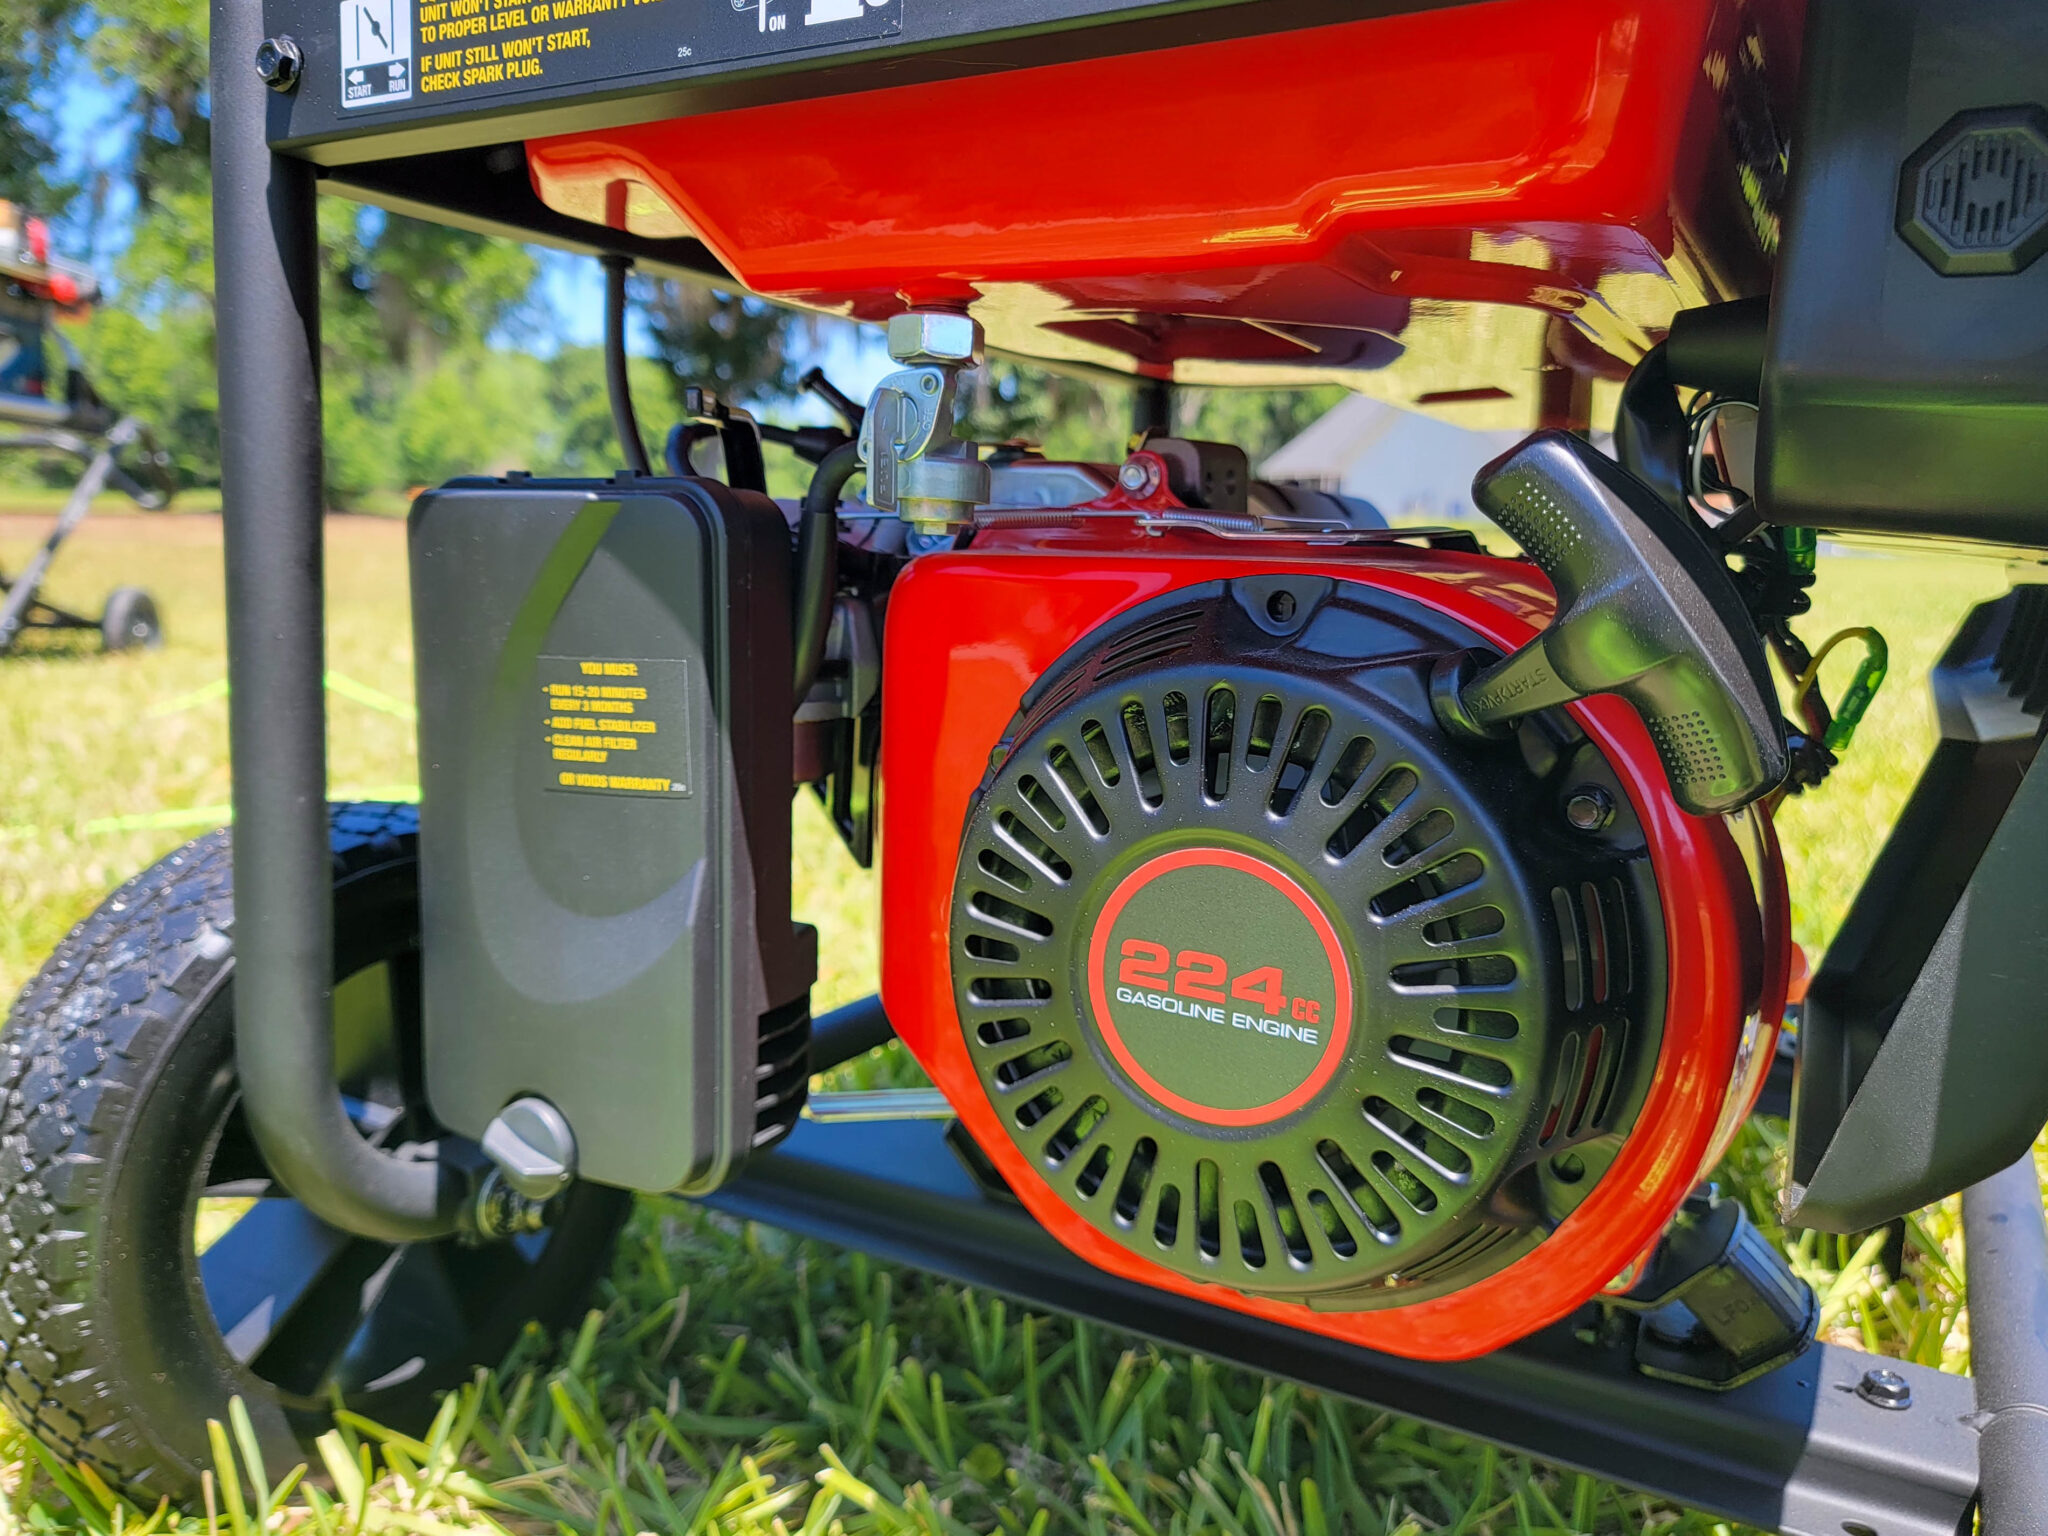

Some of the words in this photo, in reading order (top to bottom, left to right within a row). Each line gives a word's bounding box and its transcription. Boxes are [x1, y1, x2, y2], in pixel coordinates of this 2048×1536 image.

[419, 3, 448, 24] UNIT
[420, 26, 437, 44] TO
[439, 16, 488, 41] PROPER
[490, 9, 528, 31] LEVEL
[531, 4, 551, 24] OR
[768, 14, 786, 32] ON
[420, 55, 433, 73] IF
[435, 50, 463, 71] UNIT
[465, 44, 499, 66] STILL
[502, 35, 545, 60] WON'T
[547, 28, 592, 53] START,
[388, 78, 406, 93] RUN
[420, 70, 461, 94] CHECK
[463, 64, 504, 87] SPARK
[506, 57, 544, 80] PLUG.
[347, 83, 372, 99] START
[1116, 987, 1226, 1026] GASOLINE
[1231, 1012, 1319, 1046] ENGINE
